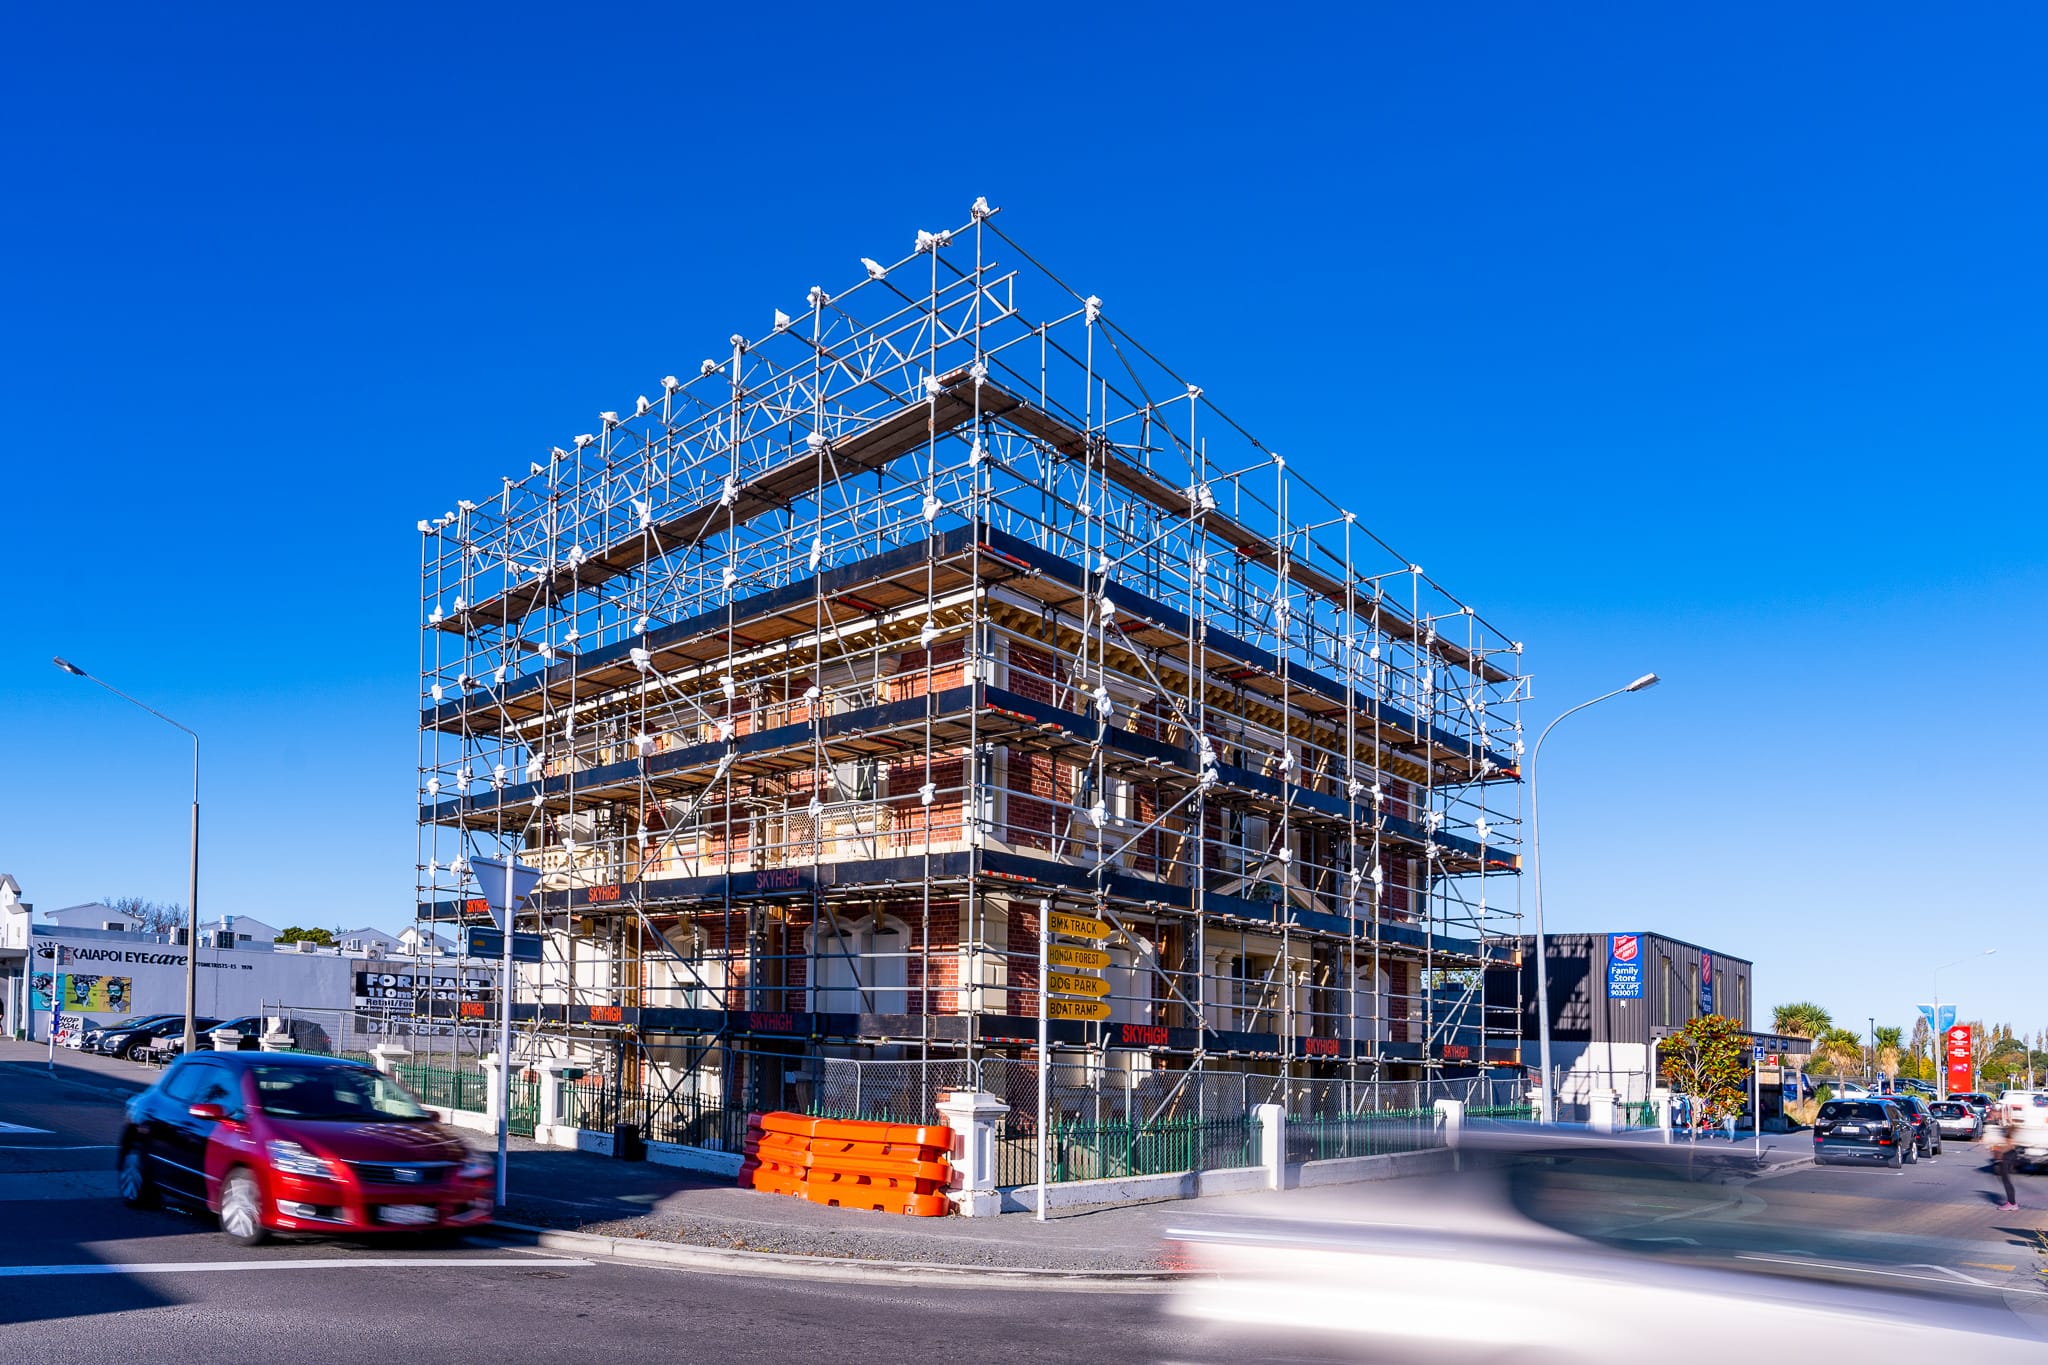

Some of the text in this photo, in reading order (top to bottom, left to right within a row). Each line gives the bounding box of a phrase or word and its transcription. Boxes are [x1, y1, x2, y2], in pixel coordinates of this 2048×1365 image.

[756, 869, 800, 889] SKYHIGH
[588, 885, 620, 902] SKYHIGH
[1051, 916, 1097, 934] BMX TRACK
[73, 948, 122, 962] KAIAPOI
[125, 951, 188, 966] EYEcare
[1049, 949, 1099, 964] HONDA FOREST
[1611, 967, 1638, 975] Family
[366, 973, 411, 987] FOR
[1050, 976, 1097, 992] DOG PARK
[461, 1002, 484, 1017] SKYHIGH
[590, 1005, 622, 1022] SKYHIGH
[1050, 1002, 1098, 1016] BOAT RAMP
[750, 1012, 793, 1031] SKYHIGH
[1122, 1023, 1168, 1045] SKYHIGH
[1305, 1038, 1339, 1056] SKYHIGH
[1443, 1045, 1469, 1059] SKYHIGH
